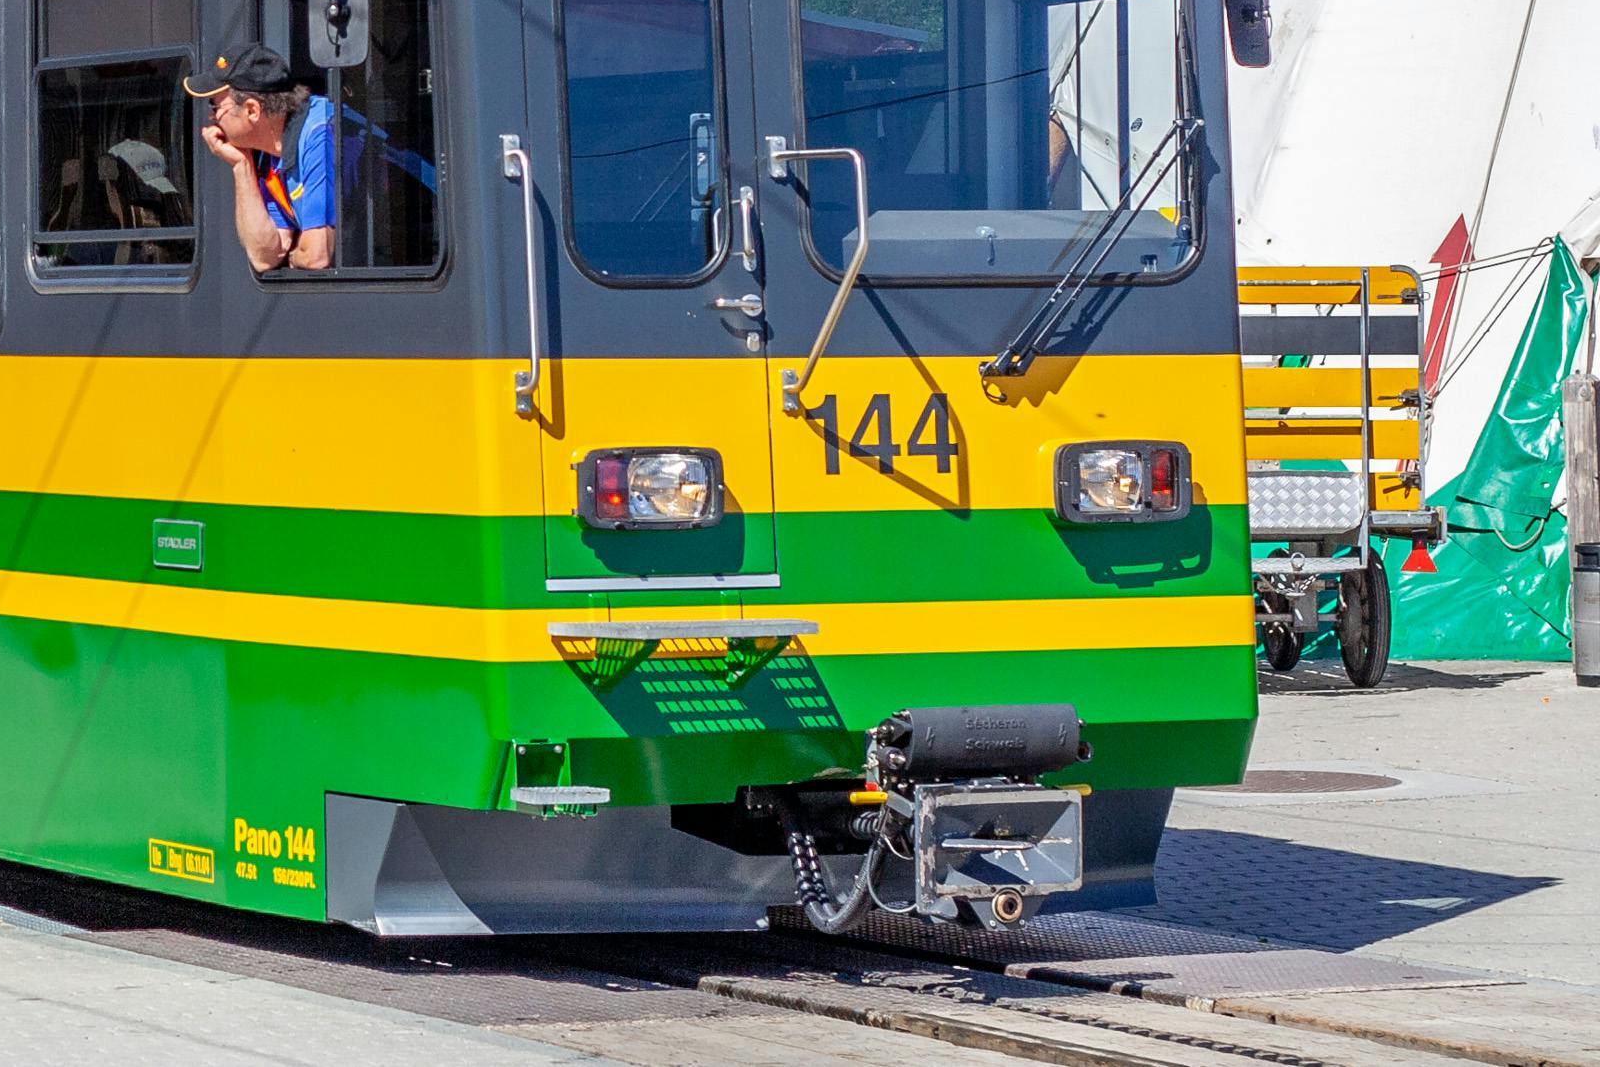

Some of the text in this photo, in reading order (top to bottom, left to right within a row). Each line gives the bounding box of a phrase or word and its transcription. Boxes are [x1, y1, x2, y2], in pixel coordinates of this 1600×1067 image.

[805, 393, 959, 475] 144
[157, 536, 196, 550] STADLER
[964, 736, 1027, 751] Schwab
[234, 818, 316, 863] Pano 144
